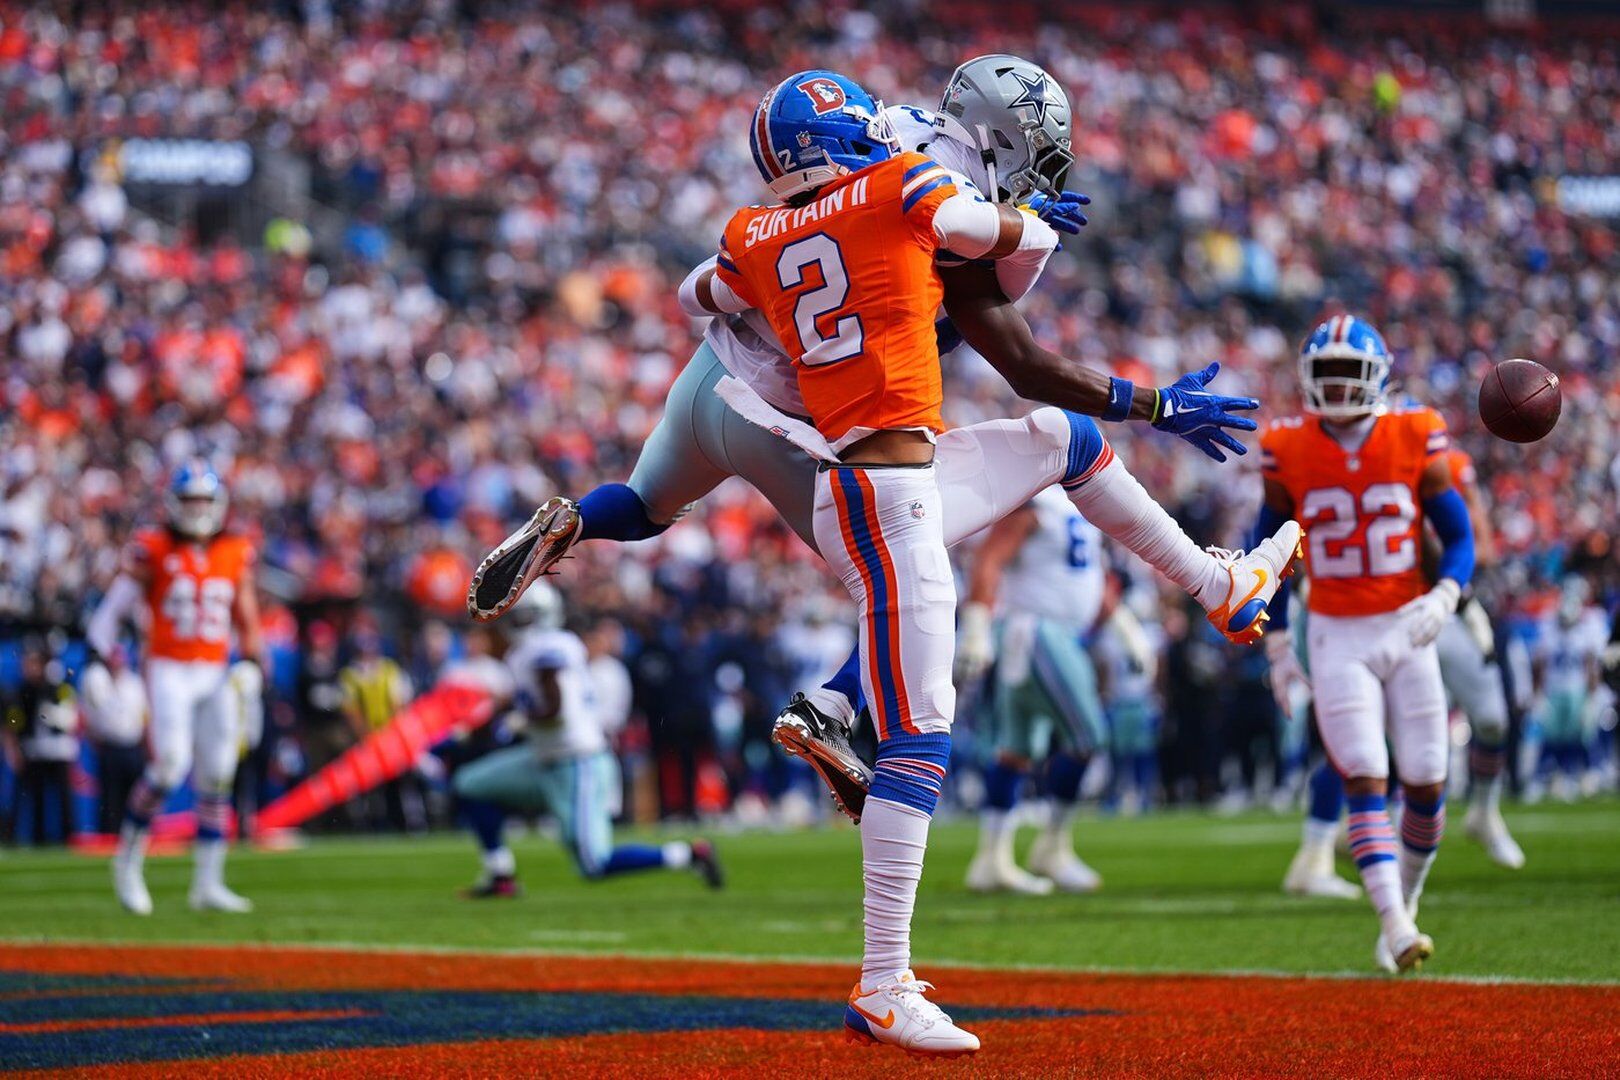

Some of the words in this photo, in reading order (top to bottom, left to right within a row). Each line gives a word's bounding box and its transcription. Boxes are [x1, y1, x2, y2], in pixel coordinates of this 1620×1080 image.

[777, 149, 797, 170] 2
[745, 185, 849, 248] SURTAIN
[851, 175, 869, 206] II
[776, 231, 864, 367] 2
[1302, 482, 1417, 578] 22
